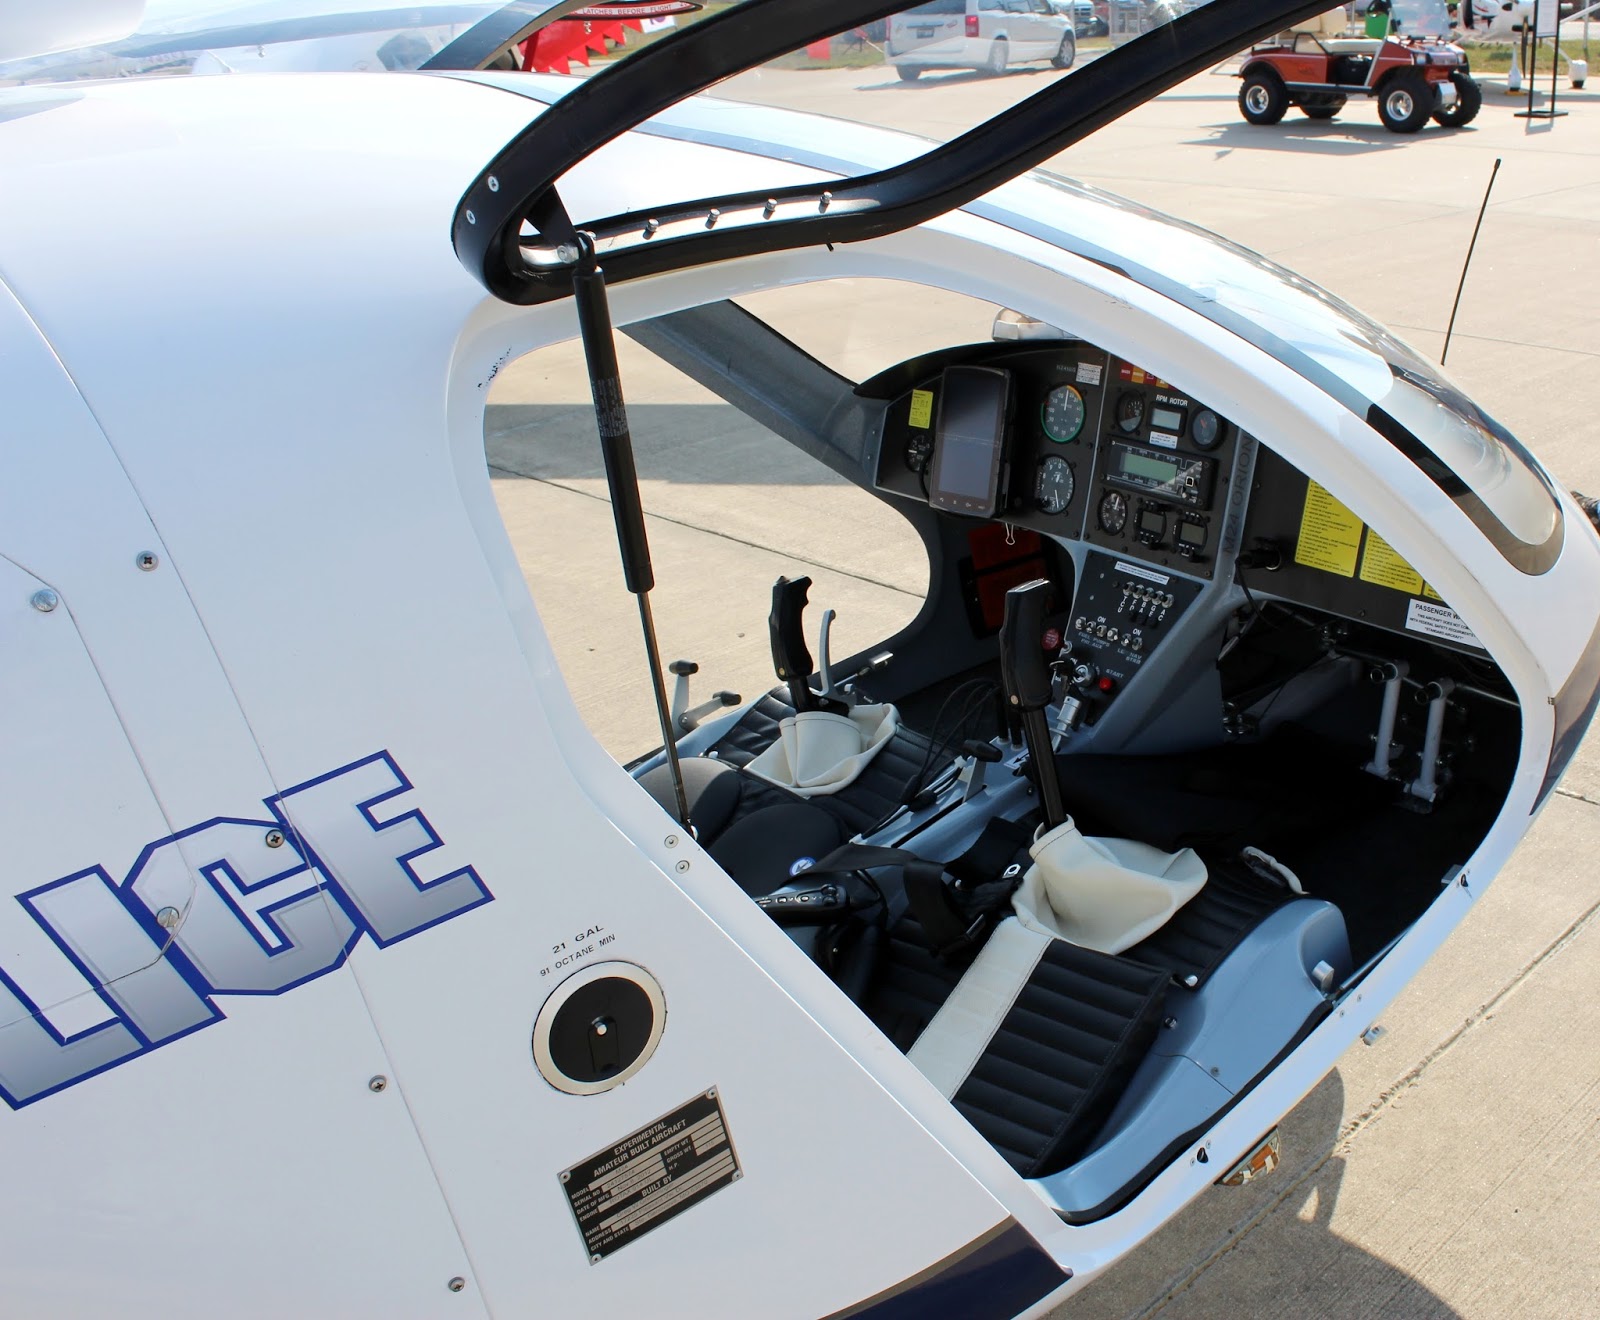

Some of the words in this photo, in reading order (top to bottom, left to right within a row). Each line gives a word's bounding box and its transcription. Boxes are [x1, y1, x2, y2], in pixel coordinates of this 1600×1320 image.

[651, 5, 671, 13] FLIGHT
[1156, 394, 1168, 402] RPM
[1169, 397, 1188, 406] ROTOR
[1232, 435, 1254, 505] ORION
[1415, 603, 1451, 617] PASSENGER
[1097, 616, 1107, 624] ON
[1425, 615, 1442, 623] AIRCRAFT
[1132, 628, 1142, 637] ON
[1105, 668, 1124, 679] START
[552, 942, 566, 954] 21
[575, 925, 604, 941] GAL
[540, 967, 550, 976] 91
[555, 945, 594, 969] OCTANE
[599, 934, 616, 947] MIN
[614, 1121, 666, 1155] EXPERIMENTAL
[593, 1153, 629, 1177] AMATEUR
[630, 1141, 650, 1156] BUILT
[651, 1119, 687, 1144] AIRCRAFT
[664, 1144, 680, 1156] EMPTY
[667, 1151, 683, 1163] GROSS
[642, 1182, 661, 1197] BUILT
[663, 1175, 673, 1184] BY
[571, 1187, 589, 1200] MODEL
[574, 1194, 592, 1207] SERIAL
[577, 1204, 590, 1215] DATE
[580, 1209, 598, 1222] ENGINE
[585, 1225, 600, 1237] NAME
[588, 1228, 611, 1244] ADDRESS
[591, 1242, 602, 1252] CITY
[603, 1236, 614, 1245] AND
[614, 1226, 629, 1238] STATE
